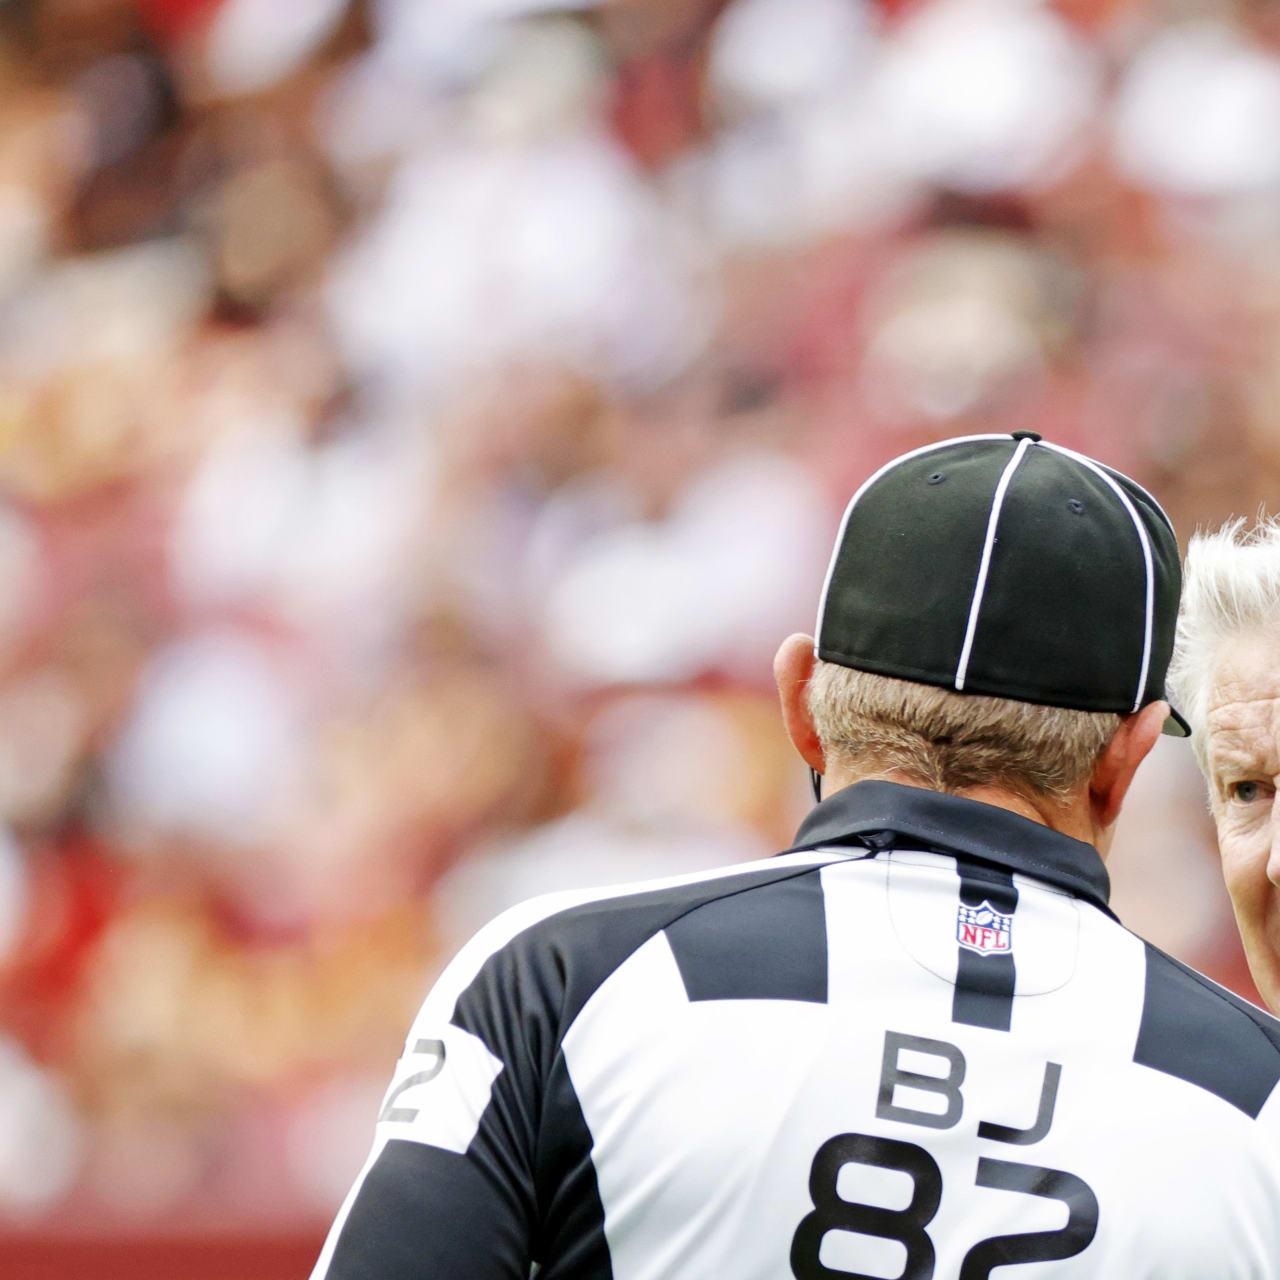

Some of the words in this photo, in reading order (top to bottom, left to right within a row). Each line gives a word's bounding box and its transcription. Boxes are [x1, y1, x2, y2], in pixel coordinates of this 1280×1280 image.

[962, 924, 1006, 949] NFL
[376, 1038, 446, 1124] 2
[875, 1030, 1063, 1146] BJ
